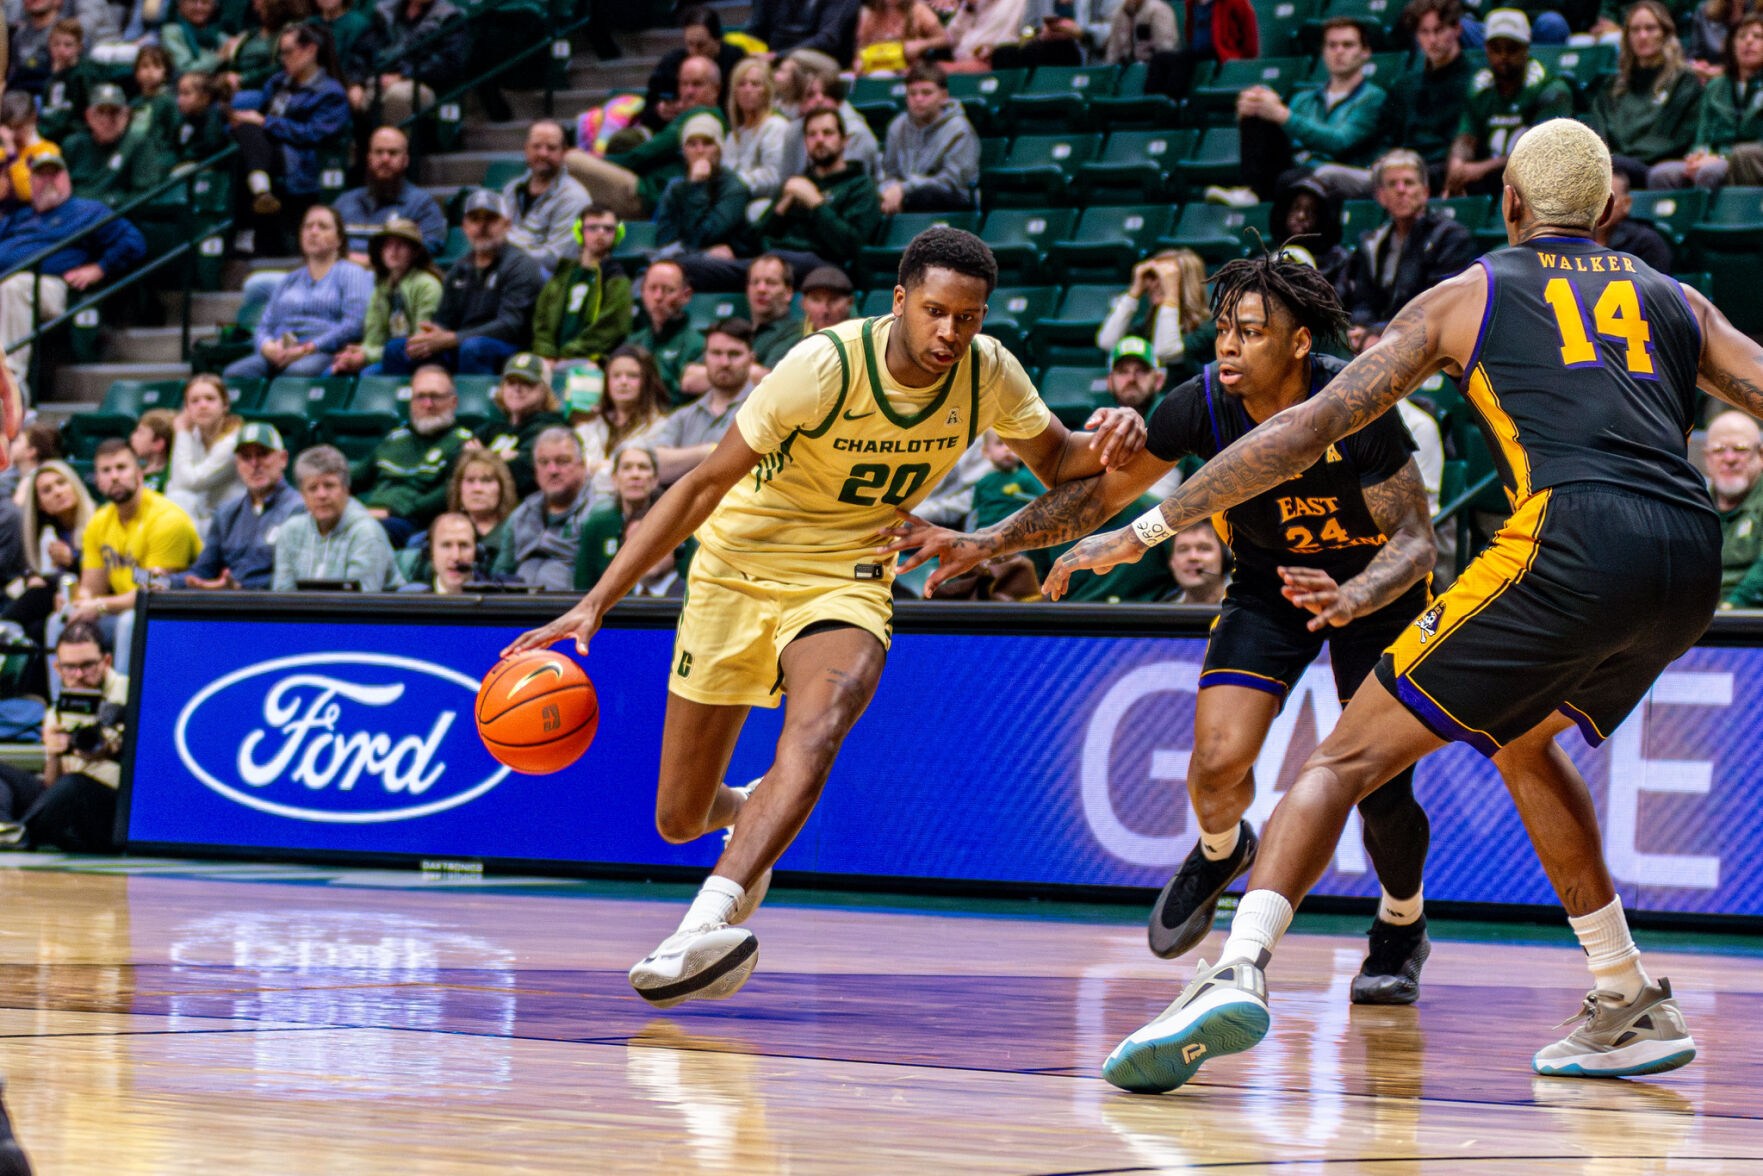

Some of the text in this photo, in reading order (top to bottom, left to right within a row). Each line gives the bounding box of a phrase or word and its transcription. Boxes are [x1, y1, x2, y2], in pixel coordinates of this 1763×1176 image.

[1537, 252, 1637, 273] WALKER
[1543, 277, 1656, 377] 14
[833, 436, 960, 453] CHARLOTTE
[838, 463, 931, 506] 20
[1276, 497, 1339, 524] EAST
[1285, 517, 1350, 548] 24
[237, 674, 456, 795] Ford
[1081, 661, 1734, 888] GAE
